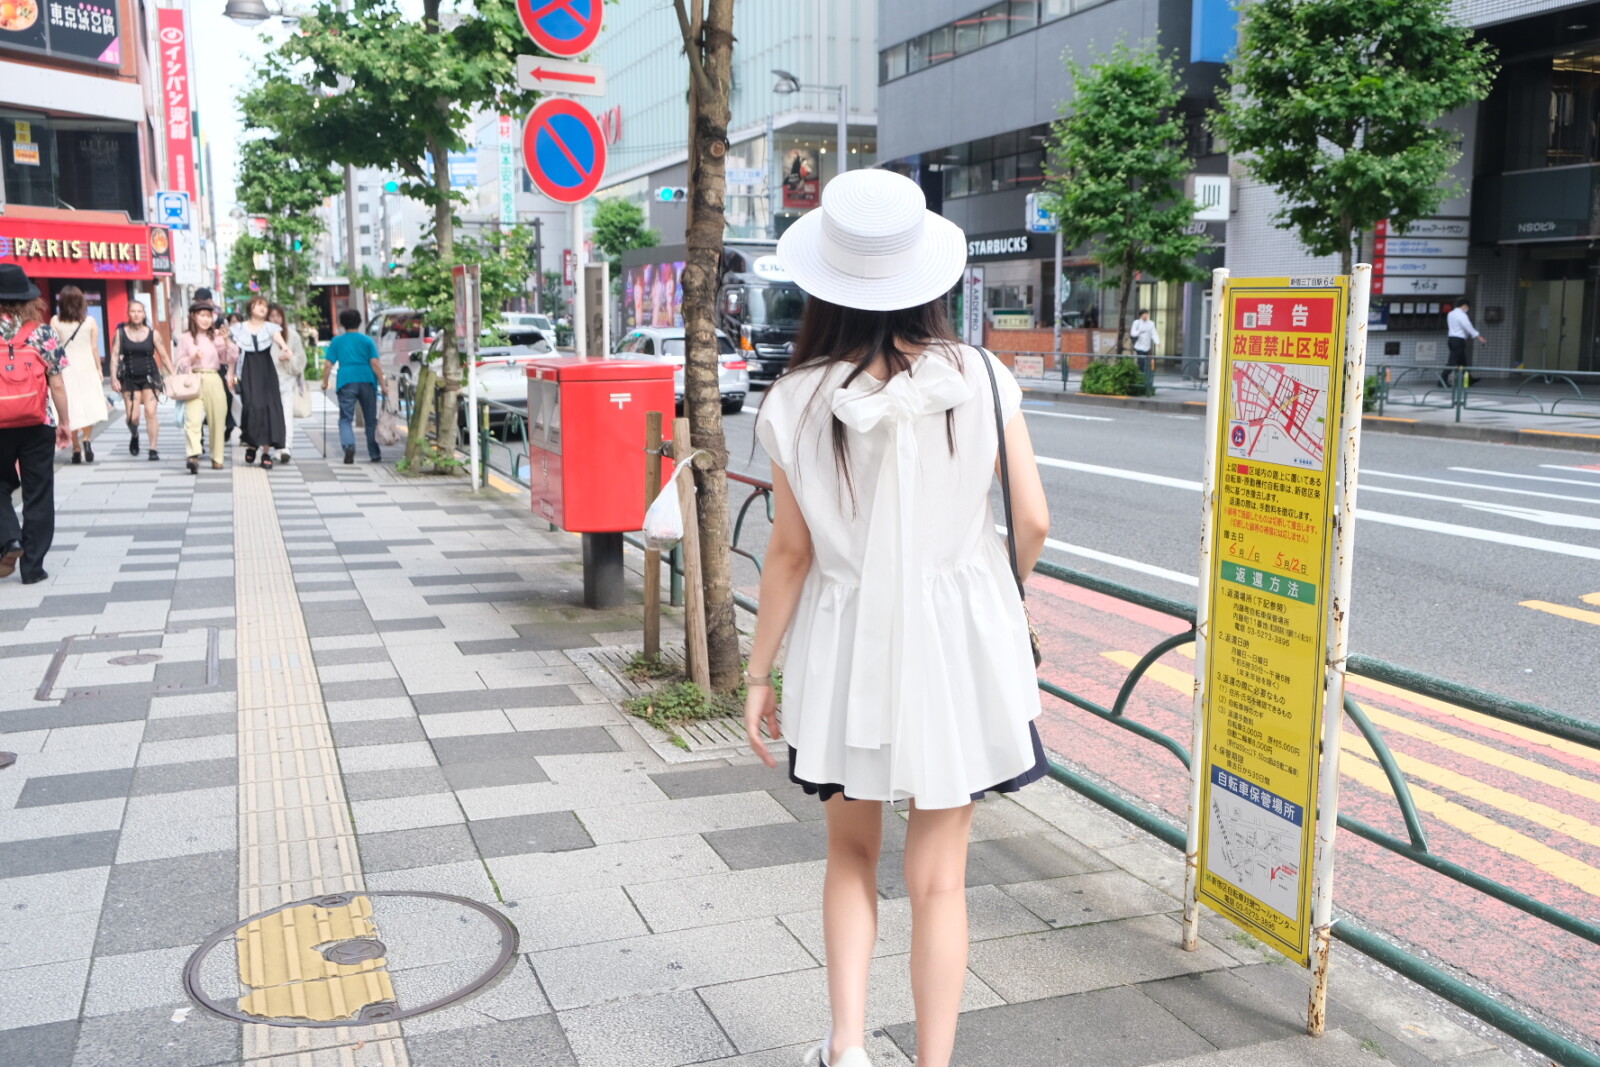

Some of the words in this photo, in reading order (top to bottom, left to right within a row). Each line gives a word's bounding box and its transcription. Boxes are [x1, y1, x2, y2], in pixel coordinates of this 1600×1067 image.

[165, 45, 189, 139] イシバシ楽器
[14, 236, 83, 260] PARIS
[90, 240, 141, 262] MIKI
[968, 235, 1028, 256] STARBUCKS
[972, 288, 980, 331] ARDEPRO
[1232, 334, 1329, 360] 放置禁止区域
[1235, 565, 1299, 598] 返還方法
[1217, 769, 1295, 821] 自転車保管場所
